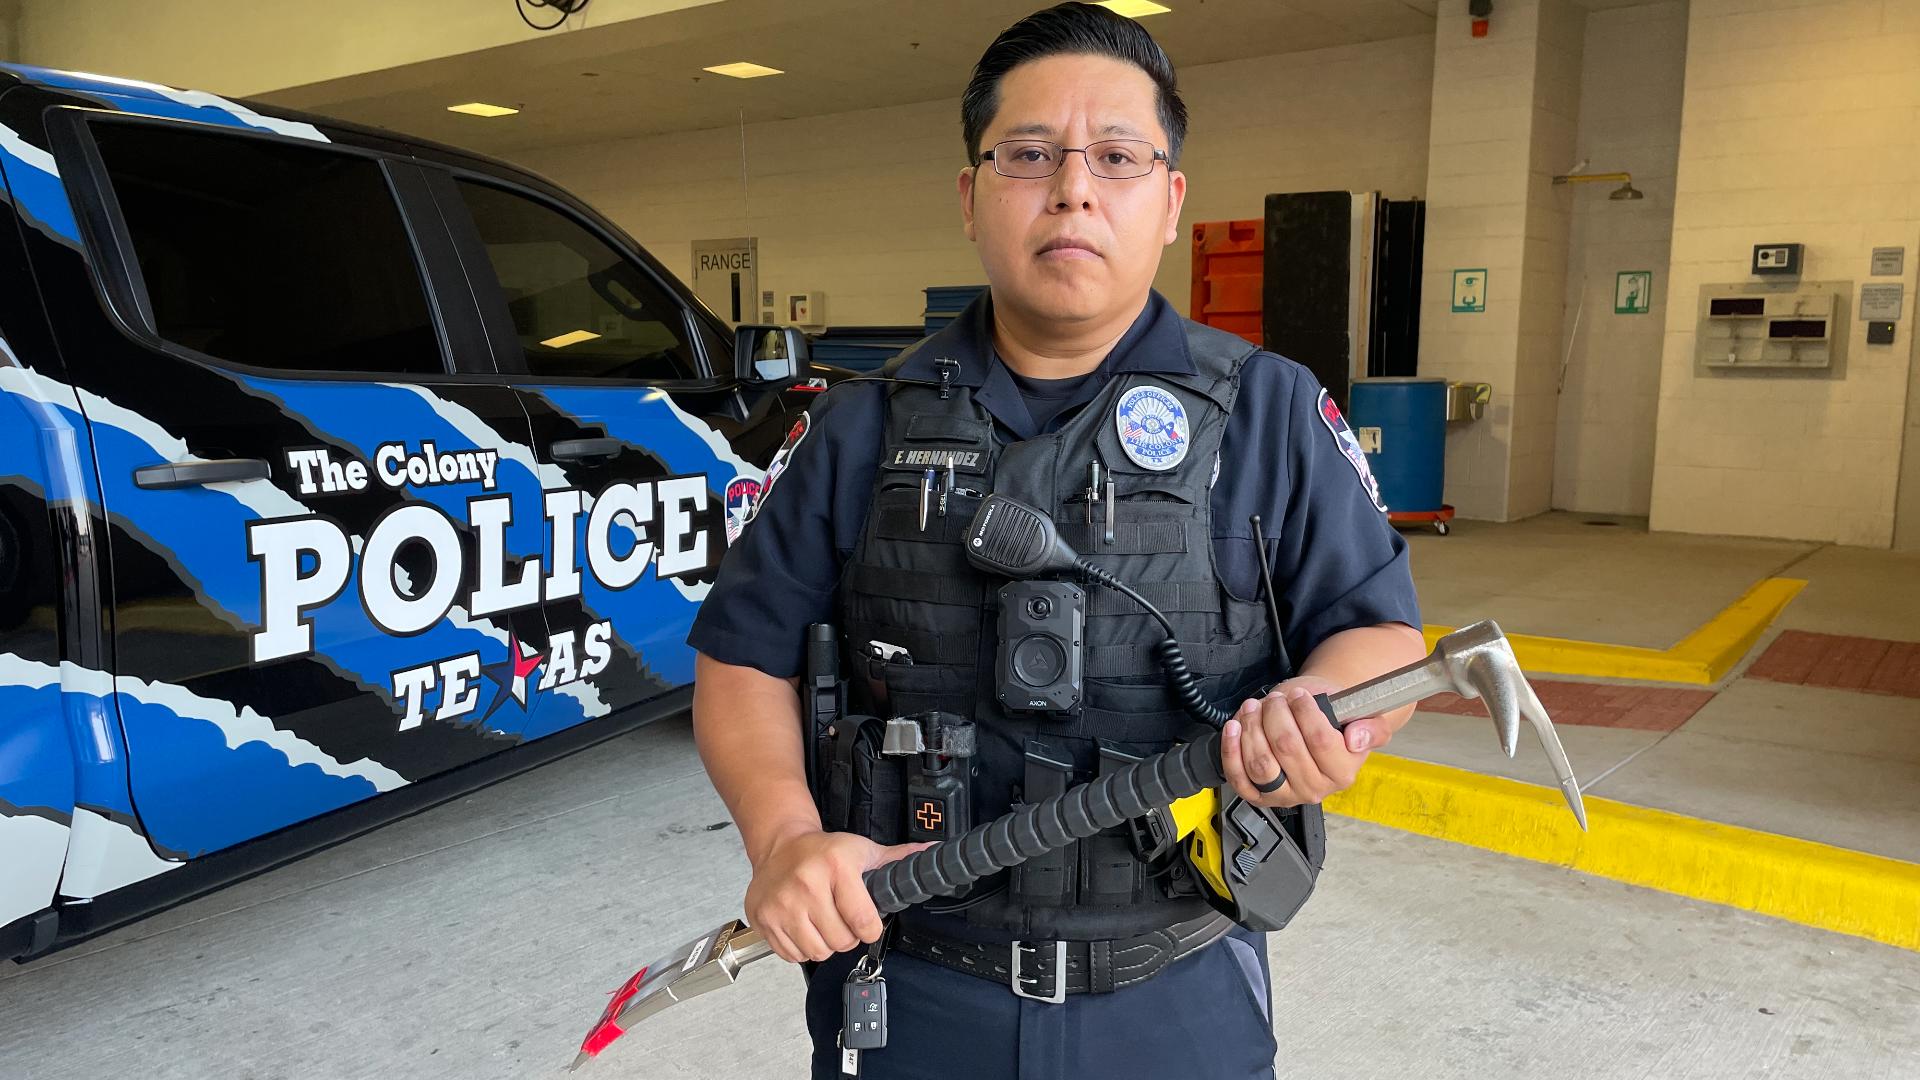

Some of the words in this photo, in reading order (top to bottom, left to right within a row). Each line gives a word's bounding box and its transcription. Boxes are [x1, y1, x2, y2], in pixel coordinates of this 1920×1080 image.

[701, 253, 751, 271] RANGE
[288, 449, 368, 495] The
[376, 443, 497, 488] Colony
[905, 450, 980, 466] HERNANDEZ
[979, 504, 996, 537] MOTOROLA
[250, 475, 708, 663] POLICE
